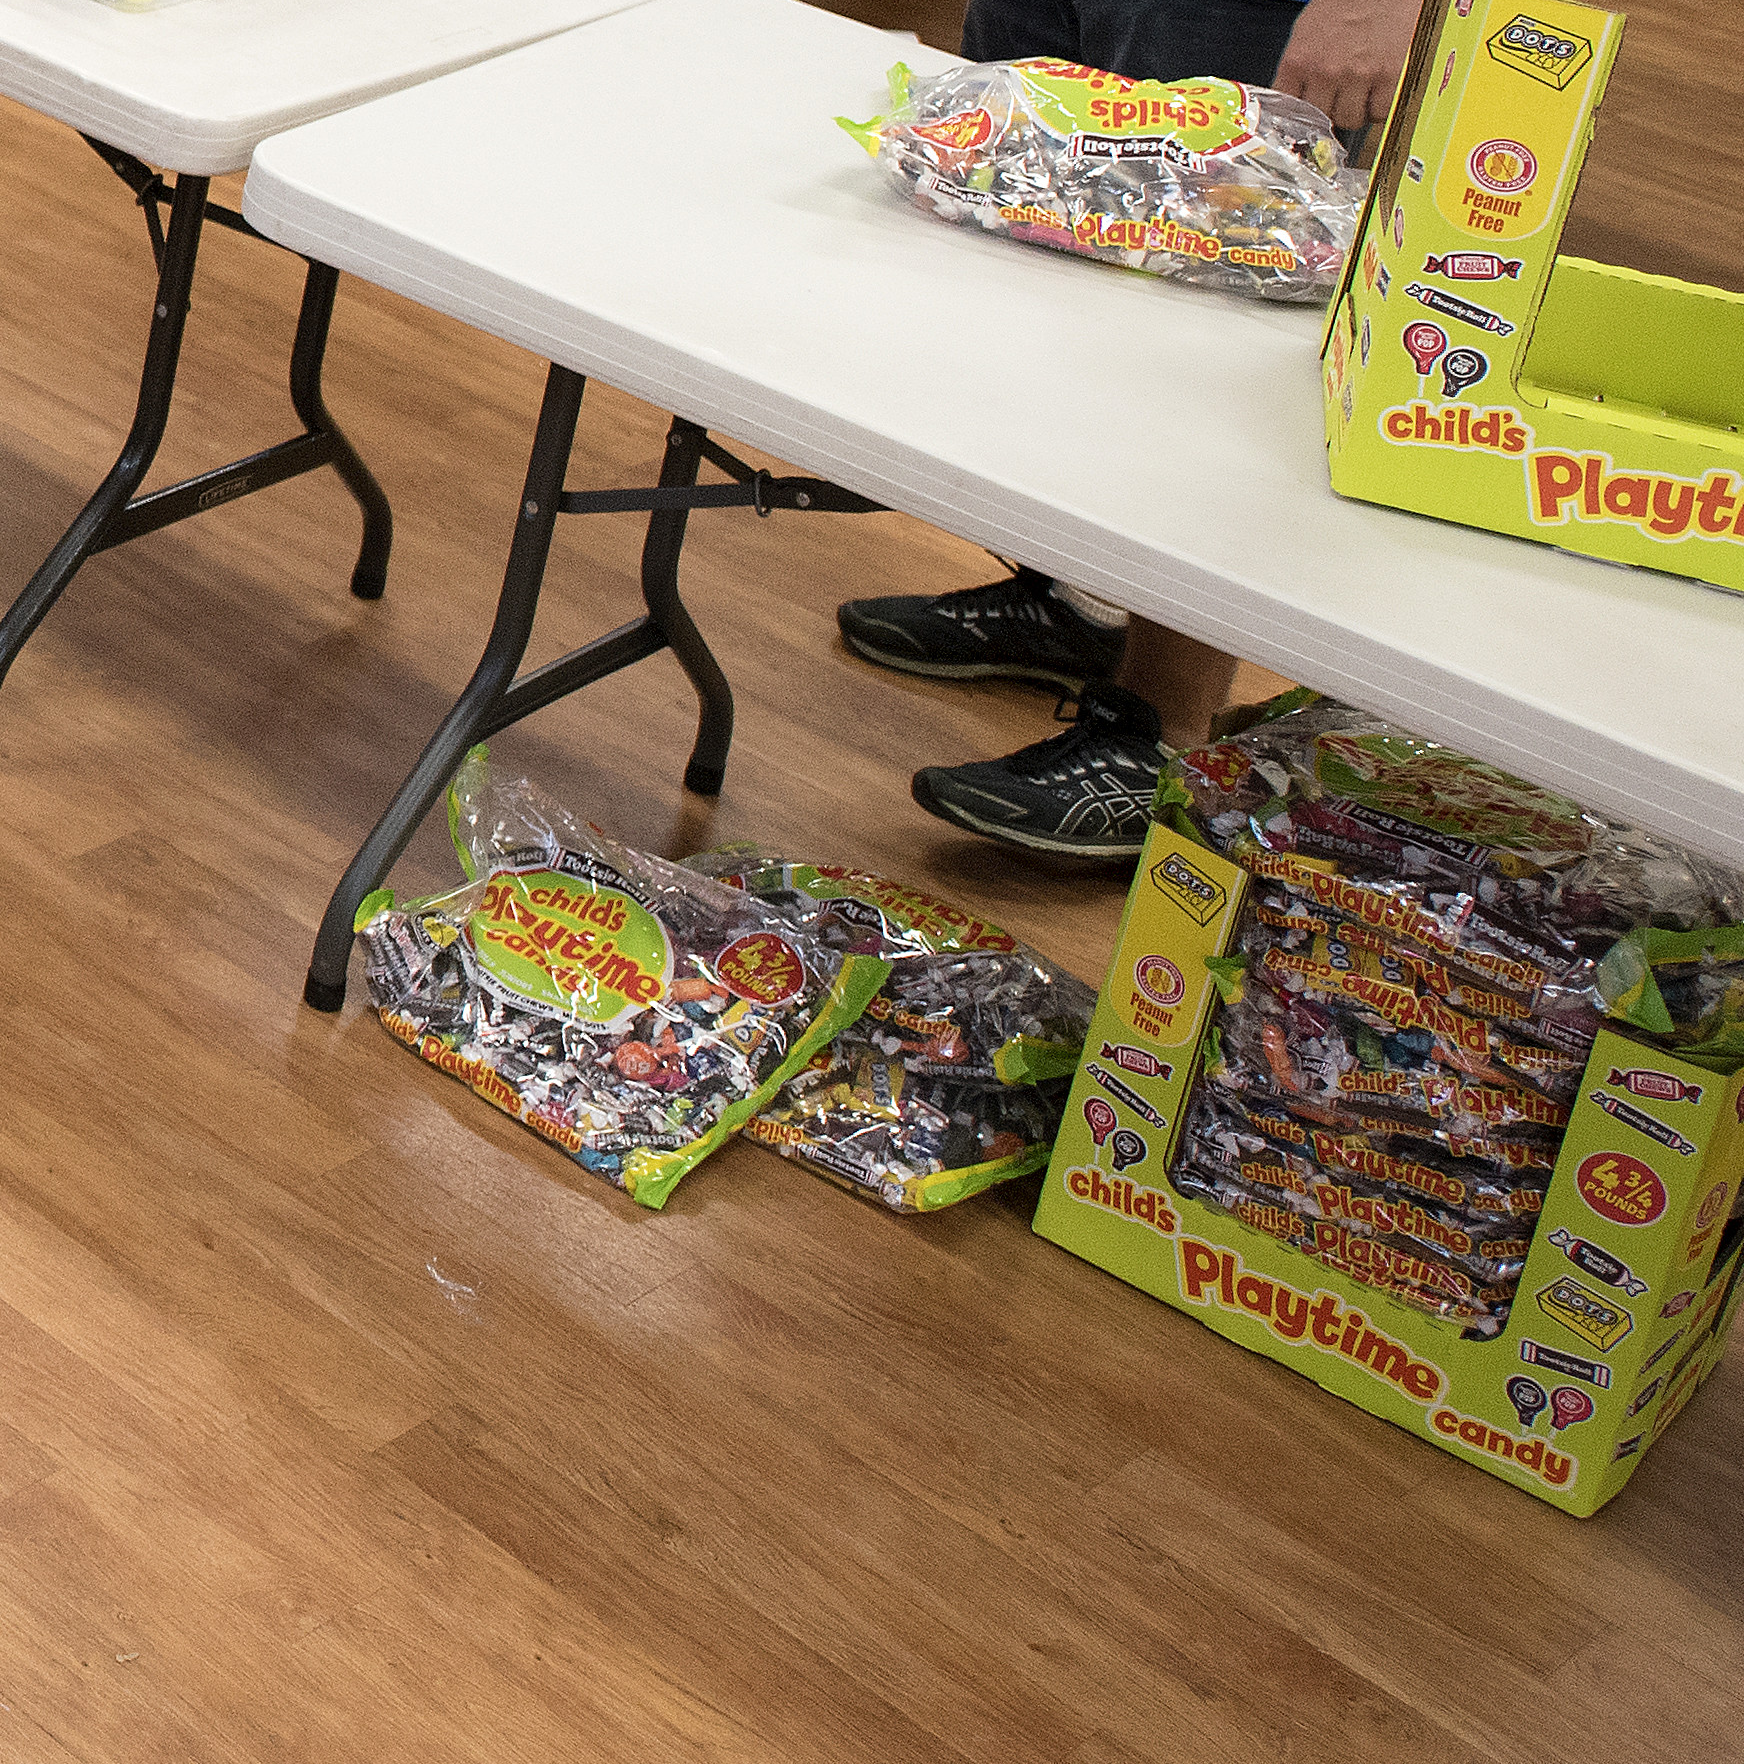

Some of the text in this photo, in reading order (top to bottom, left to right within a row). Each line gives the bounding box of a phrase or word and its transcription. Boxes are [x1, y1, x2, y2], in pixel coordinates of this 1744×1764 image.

[1507, 24, 1575, 60] DOTS
[1461, 187, 1522, 219] Peanut
[1467, 210, 1505, 234] Free
[1072, 215, 1222, 260] Playtime
[1228, 246, 1296, 272] candy
[1386, 407, 1744, 535] child's Playt
[1165, 861, 1216, 900] DOTS
[529, 886, 627, 934] child's
[1312, 871, 1457, 955] Playtime
[478, 885, 661, 1004] Playtime
[739, 940, 768, 968] 4
[722, 961, 777, 1003] POUNDS
[1129, 992, 1175, 1028] Peanut
[1132, 1013, 1161, 1038] Free
[421, 1036, 583, 1152] Playtime candy
[1338, 1072, 1411, 1097] child's
[1421, 1077, 1568, 1127] Playtim
[1313, 1132, 1465, 1204] Playtime
[1591, 1158, 1620, 1190] 4
[1240, 1162, 1308, 1196] child's
[1315, 1185, 1472, 1255] Playtime
[1583, 1180, 1648, 1222] POUNDS
[1238, 1201, 1472, 1296] child's Playtime
[1556, 1286, 1614, 1323] DOTS
[1069, 1169, 1573, 1487] child's Playtime candy
